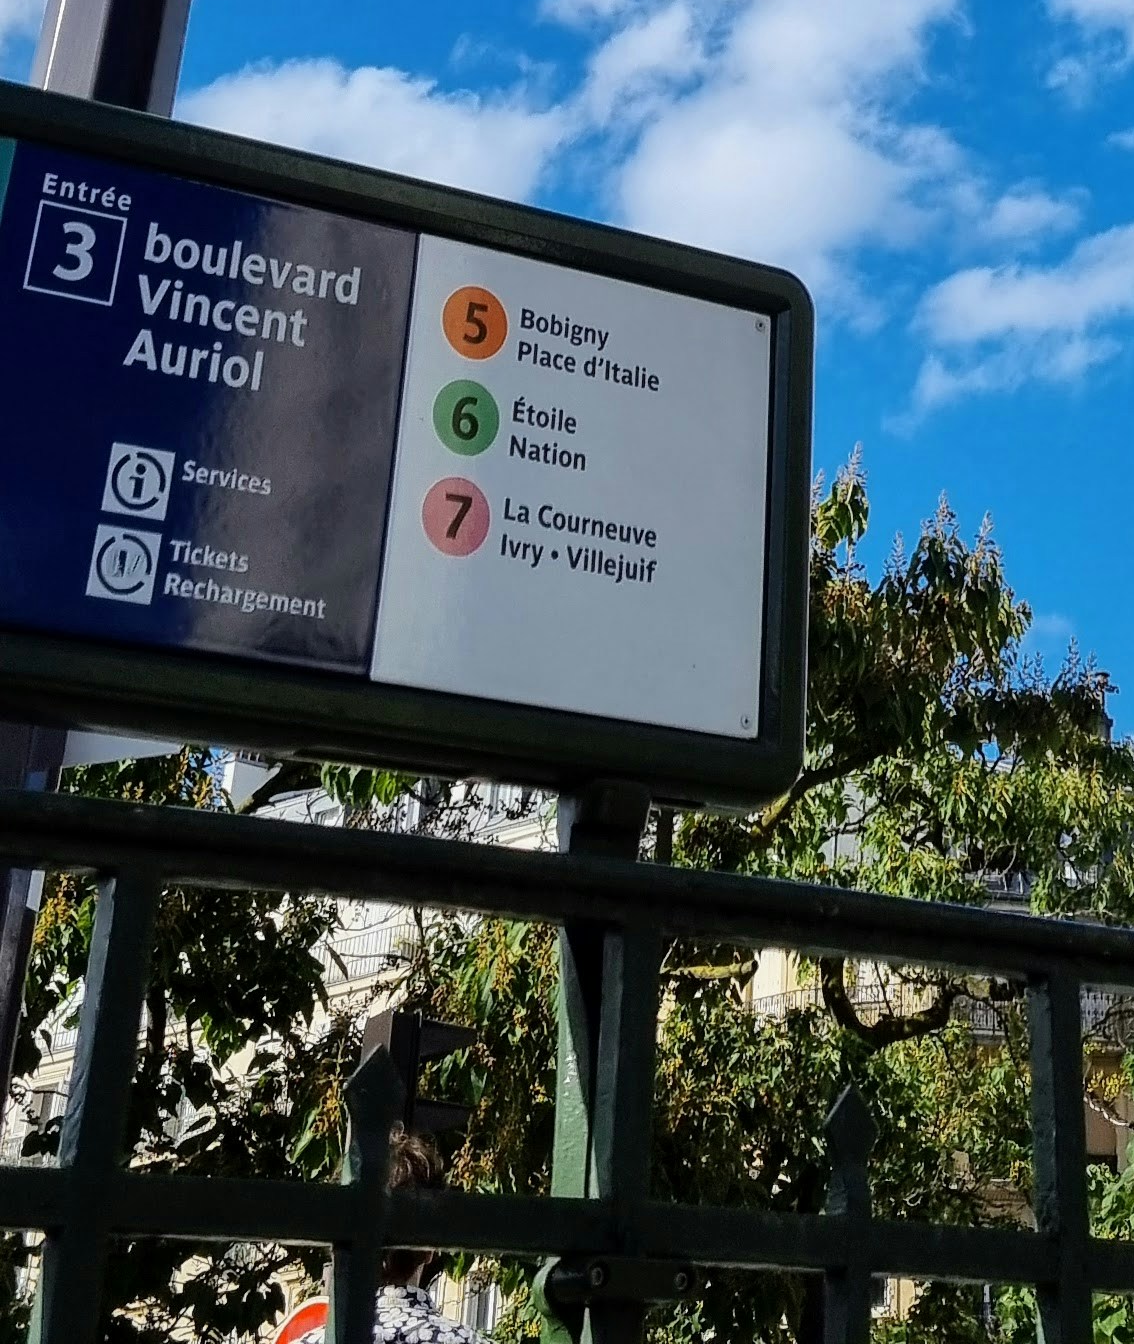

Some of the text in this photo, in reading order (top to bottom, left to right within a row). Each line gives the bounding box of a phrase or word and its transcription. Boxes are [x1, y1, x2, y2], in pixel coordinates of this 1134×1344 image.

[42, 172, 132, 211] Entrée
[52, 221, 97, 282] 3
[143, 221, 362, 306] boulevard
[138, 274, 308, 348] Vincent
[462, 301, 489, 345] 5
[520, 307, 610, 352] Bobigny
[122, 330, 265, 392] Auriol
[517, 340, 660, 392] Place d'Italie
[451, 396, 480, 441] 6
[512, 395, 577, 435] Étoile
[509, 435, 586, 471] Nation
[181, 460, 272, 496] Services
[445, 492, 473, 540] 7
[503, 497, 657, 548] La Courneuve
[169, 539, 249, 573] Tickets
[500, 533, 658, 584] Ivry Villejuif
[163, 572, 327, 620] Rechargement
